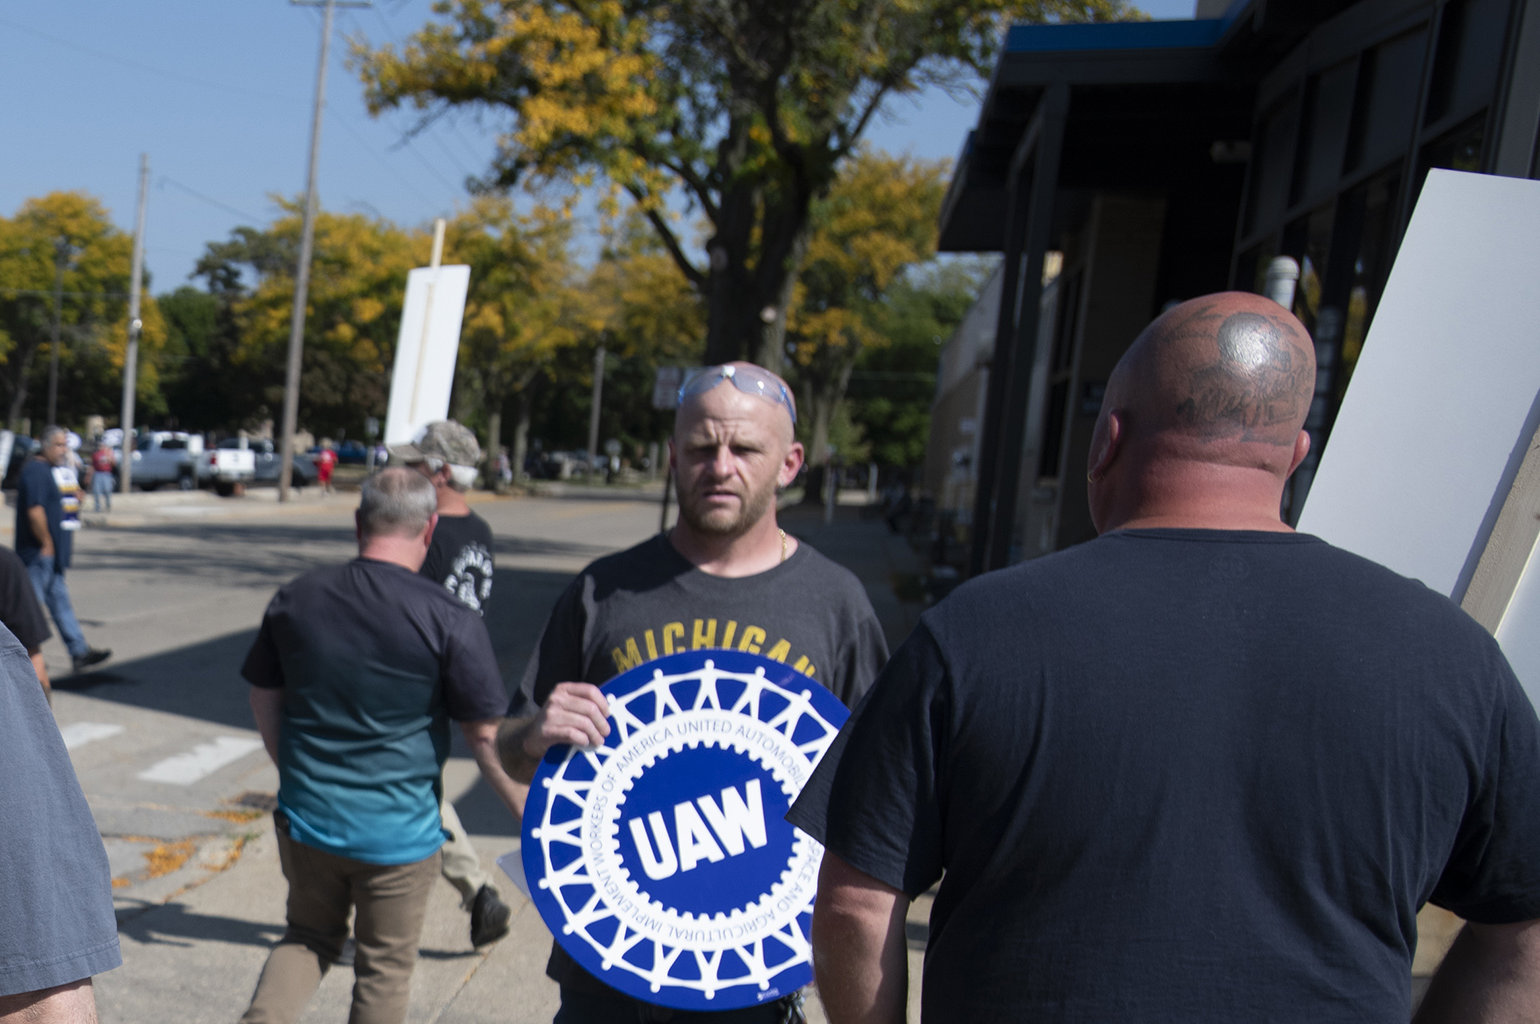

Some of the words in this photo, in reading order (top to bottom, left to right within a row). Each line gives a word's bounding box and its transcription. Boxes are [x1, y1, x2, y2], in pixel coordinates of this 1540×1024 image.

[676, 718, 733, 735] UNITED
[616, 727, 674, 773] AMERICA
[735, 724, 806, 791] AUTOMOBIL
[601, 773, 618, 793] OF
[589, 794, 608, 867] WORKERS
[629, 779, 767, 880] UAW
[798, 840, 820, 883] SPACE
[596, 870, 662, 933] IMPLEMENT
[776, 882, 804, 912] AND
[667, 909, 776, 942] AGRICULTURAL
